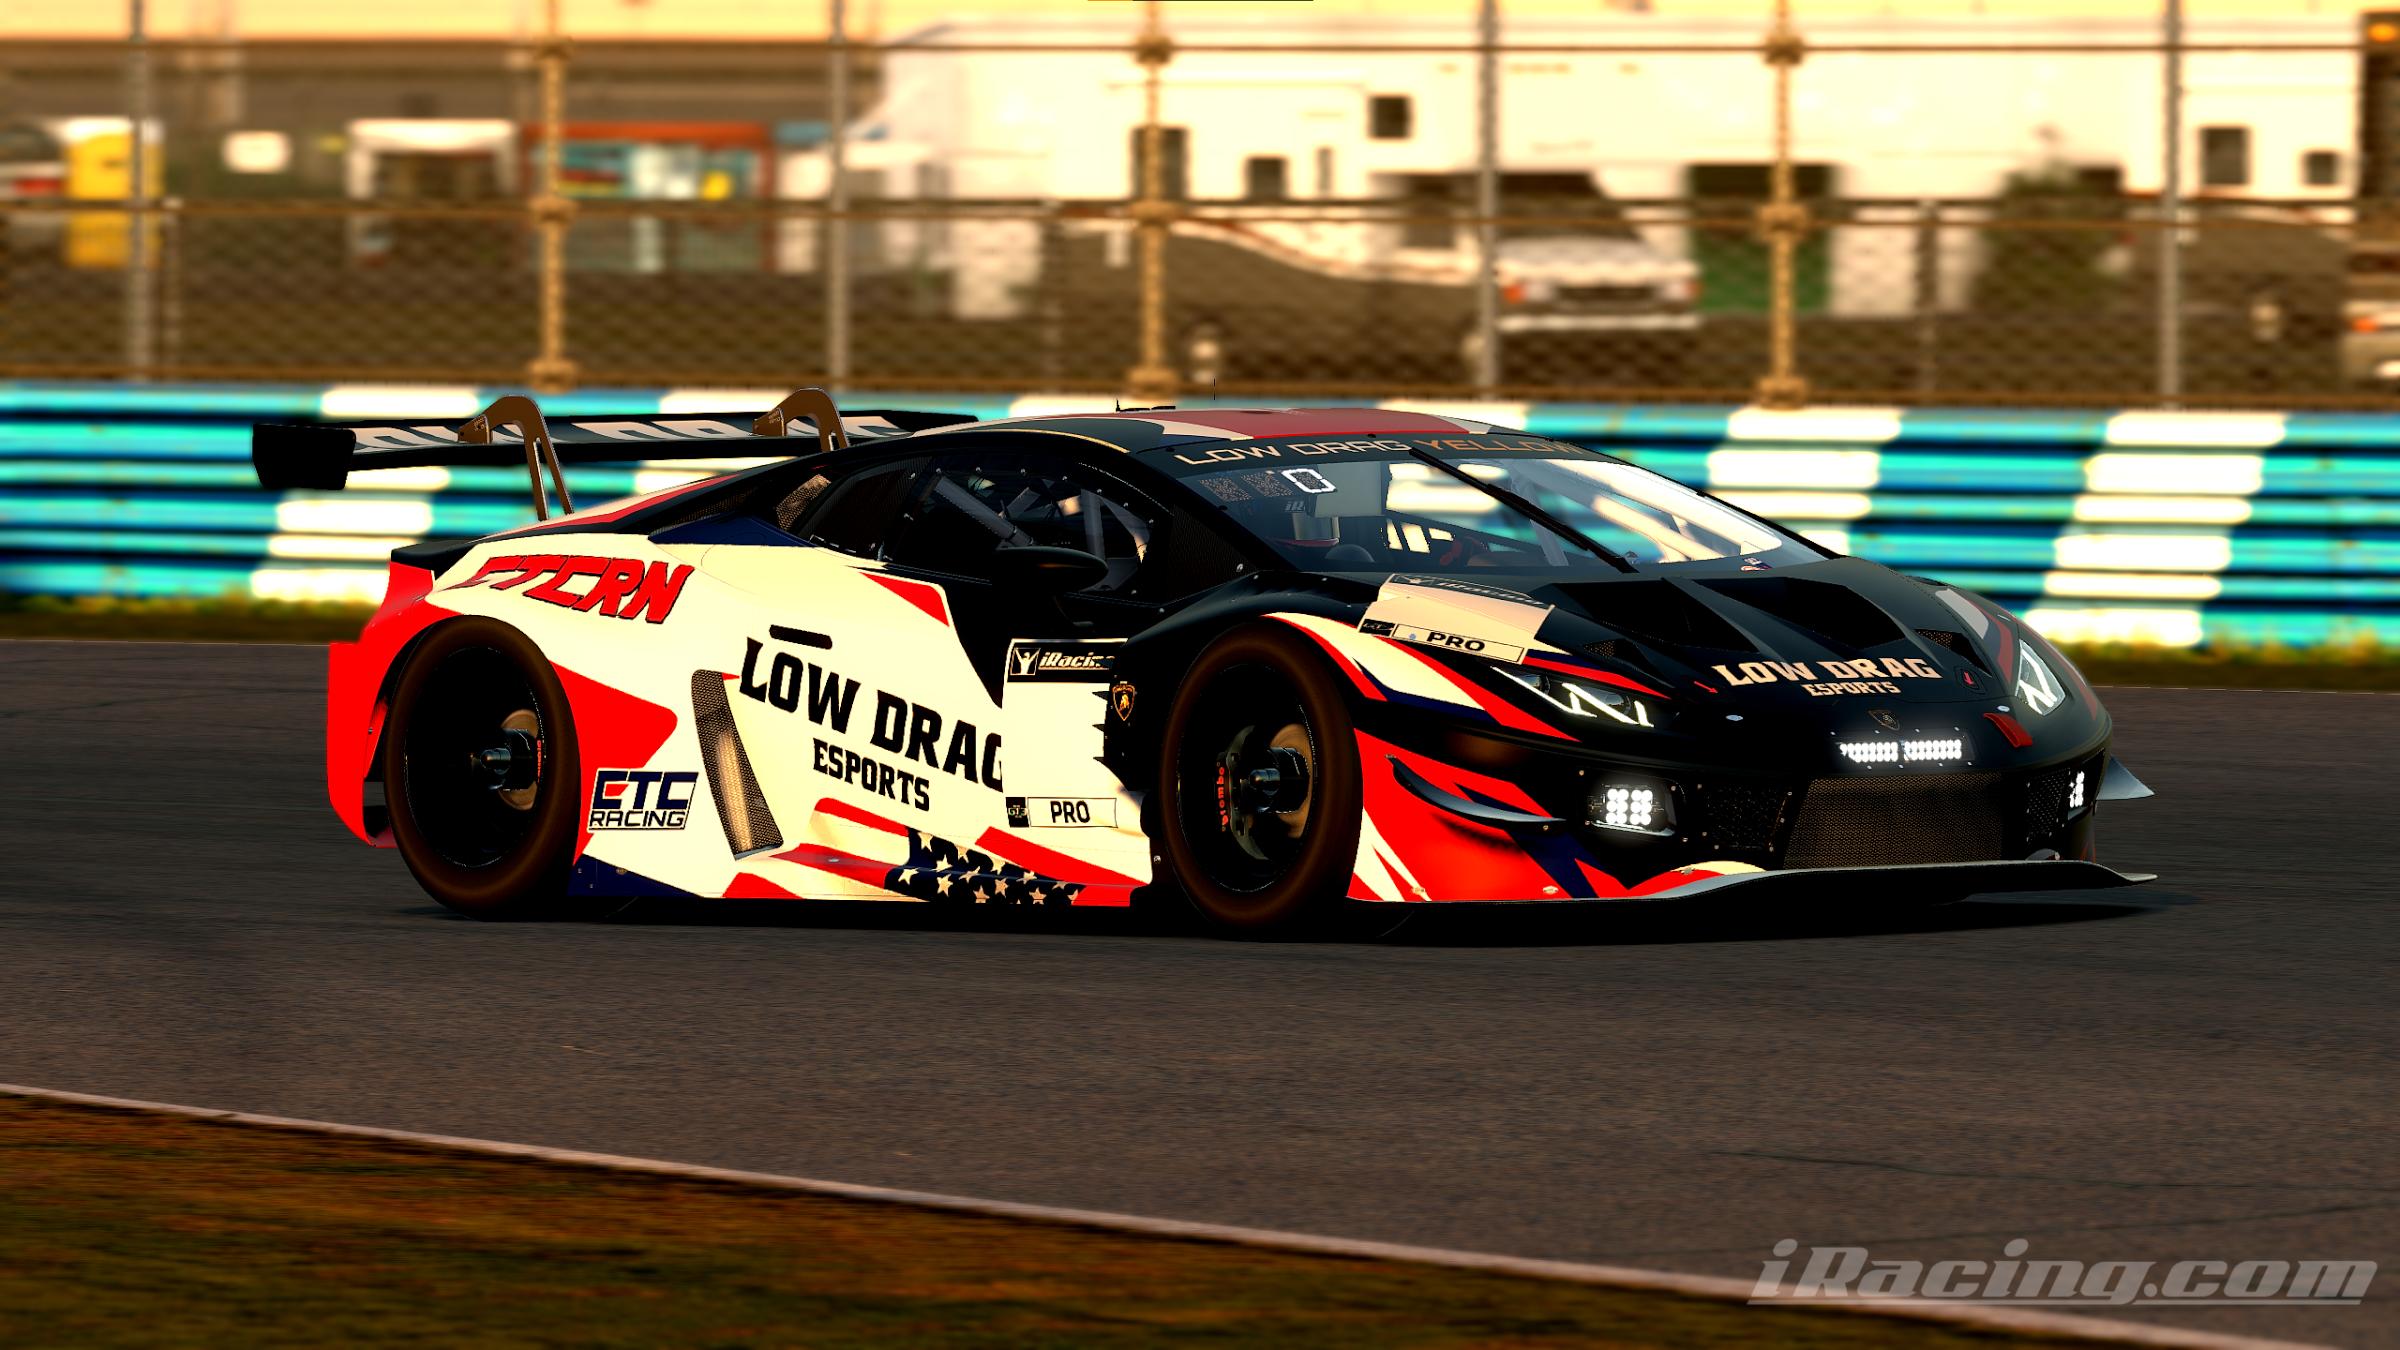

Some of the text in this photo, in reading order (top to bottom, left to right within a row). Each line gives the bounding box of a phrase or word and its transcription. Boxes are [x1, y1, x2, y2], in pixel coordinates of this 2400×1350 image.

[1174, 445, 1281, 465] LOW
[1286, 440, 1412, 455] DRAG
[1426, 631, 1485, 652] PRO
[1711, 658, 1943, 686] LOW DRAG
[739, 636, 861, 734] LOW
[1801, 681, 1902, 697] ESPORTS
[813, 737, 929, 812] ESPORTS
[591, 770, 699, 810] ETC
[589, 810, 686, 828] RACING
[1050, 800, 1091, 823] PRO
